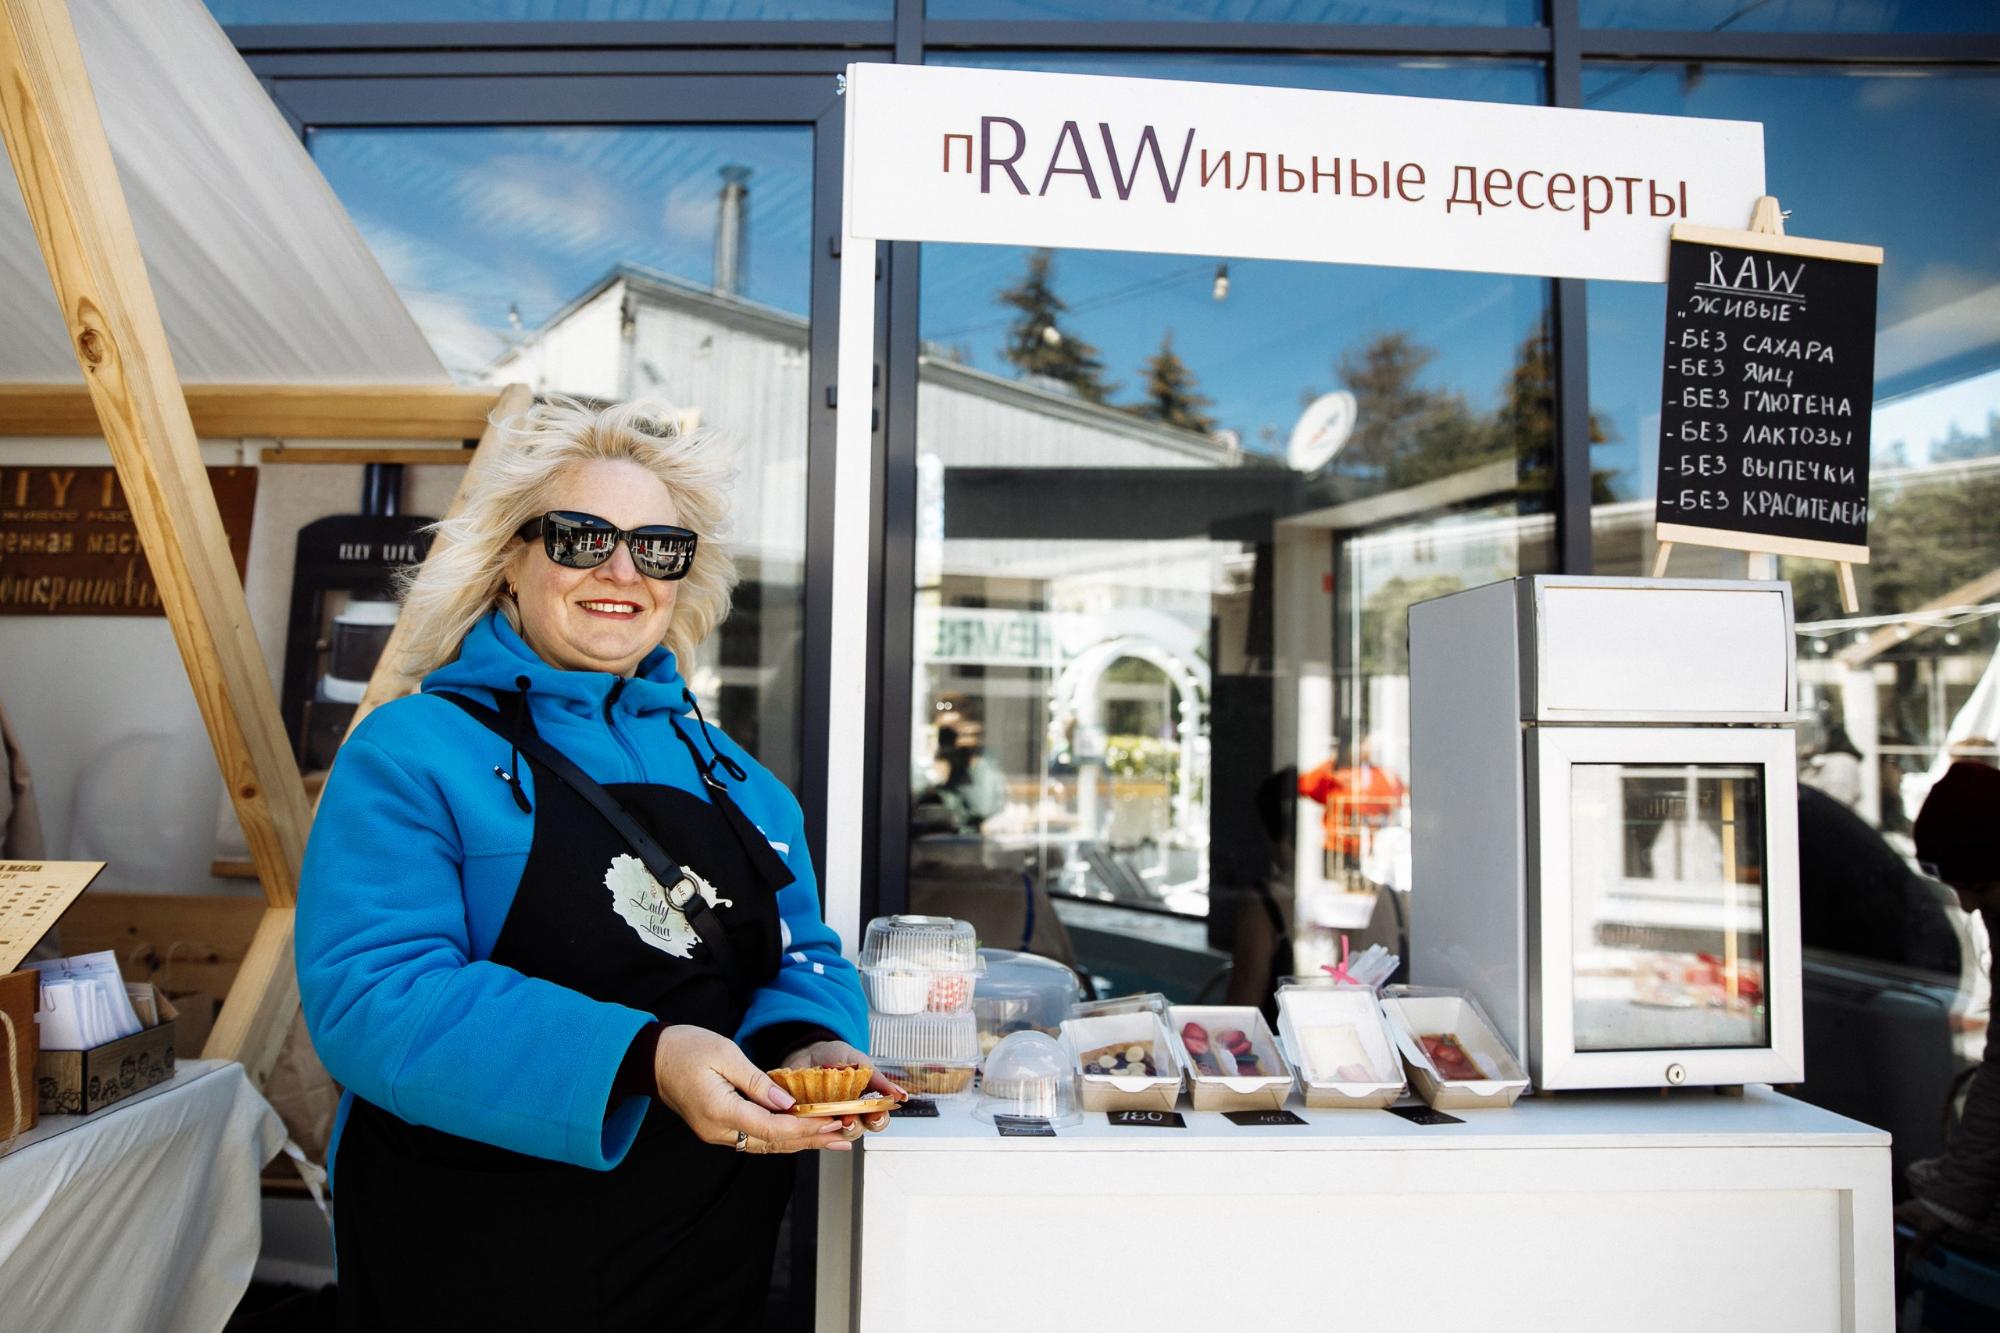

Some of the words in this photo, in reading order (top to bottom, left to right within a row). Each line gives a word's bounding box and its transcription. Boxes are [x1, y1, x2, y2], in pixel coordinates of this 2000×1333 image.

[943, 115, 1426, 203] пRAWильные
[1446, 165, 1688, 231] десерты
[1709, 250, 1806, 294] RAW
[1743, 334, 1834, 364] САХАРА
[1742, 362, 1794, 388] ЯИЦ
[1743, 389, 1852, 416] ГЛЮТЕНА
[1742, 424, 1852, 446] ЛАКТОЗЫ
[1742, 456, 1856, 485] ВЫПЕЧКИ
[1742, 490, 1867, 526] КРАСИТЕЛЕЙ
[0, 531, 74, 558] енная
